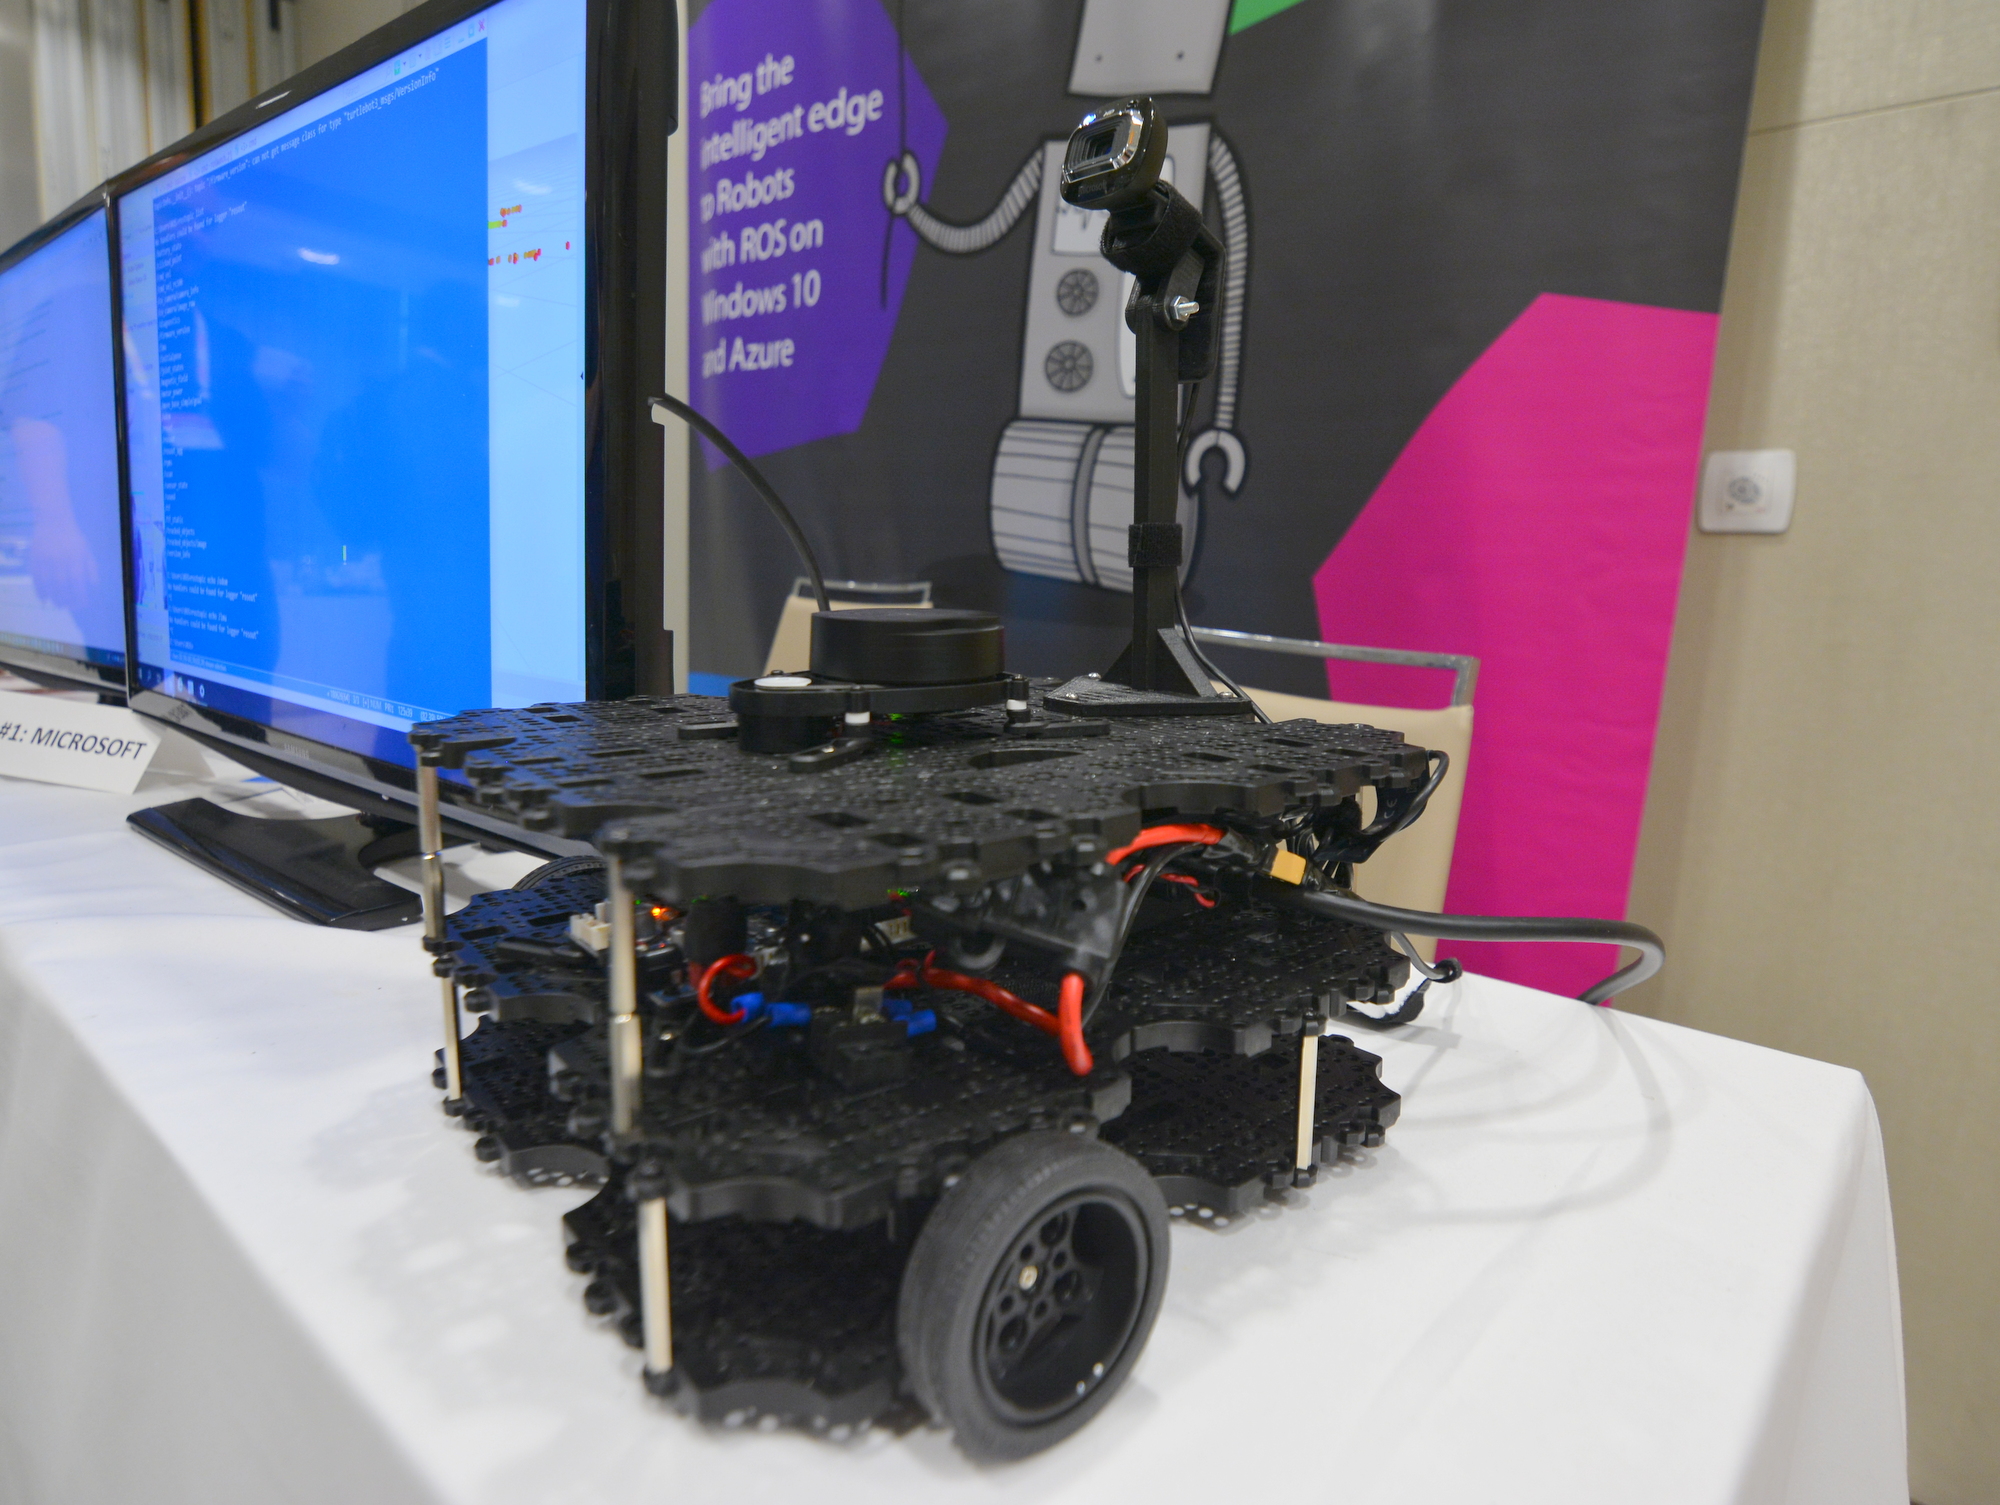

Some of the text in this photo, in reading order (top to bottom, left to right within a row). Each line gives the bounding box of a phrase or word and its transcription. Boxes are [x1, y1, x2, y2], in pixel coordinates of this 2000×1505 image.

[756, 52, 795, 95] the
[302, 129, 316, 142] class
[318, 123, 327, 135] for
[329, 117, 342, 131] type
[807, 86, 884, 137] edge
[716, 167, 796, 216] Robots
[740, 218, 788, 264] ROS
[789, 219, 824, 254] on
[792, 269, 822, 309] 10
[728, 336, 796, 373] Azure
[30, 727, 147, 760] MICROSOFT
